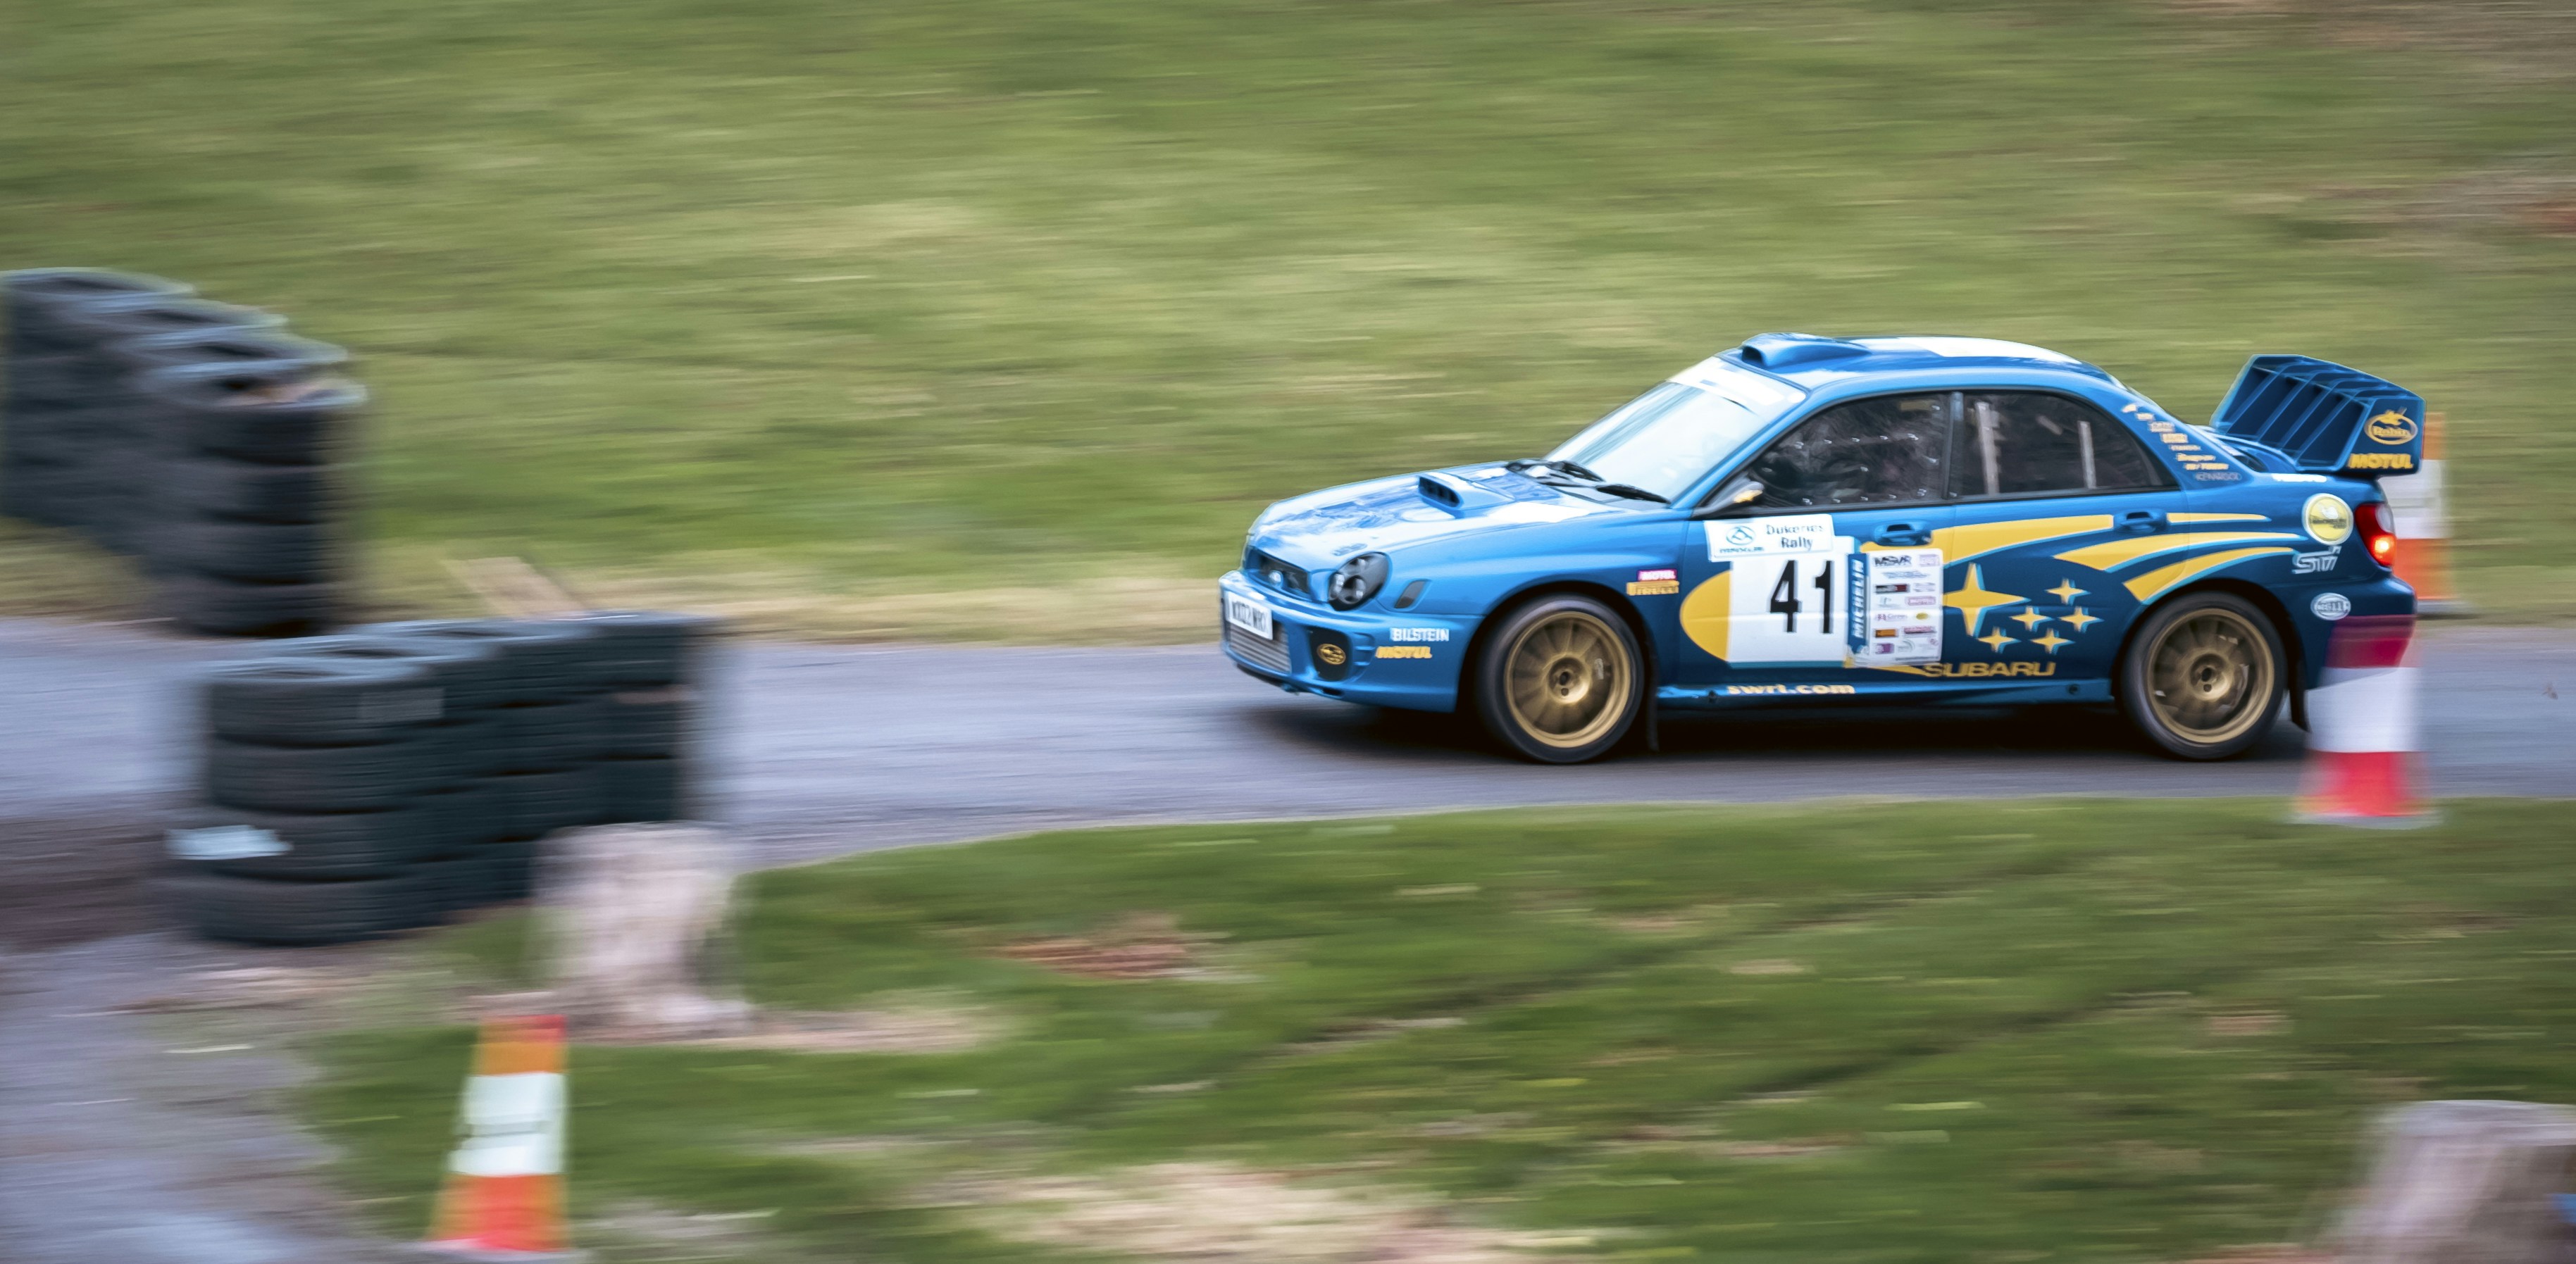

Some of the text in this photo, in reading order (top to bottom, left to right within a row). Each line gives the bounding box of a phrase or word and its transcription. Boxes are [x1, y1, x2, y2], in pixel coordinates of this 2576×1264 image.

[2348, 453, 2413, 469] MOTUL
[1780, 536, 1813, 551] Rally
[1768, 560, 1834, 634] 41
[1852, 558, 1865, 639] MICHELIN
[1390, 627, 1450, 642] BILSTEIN
[1376, 646, 1433, 658] MOTUL
[1924, 662, 2056, 677] SUBARU
[1727, 684, 1855, 694] swrt.com
